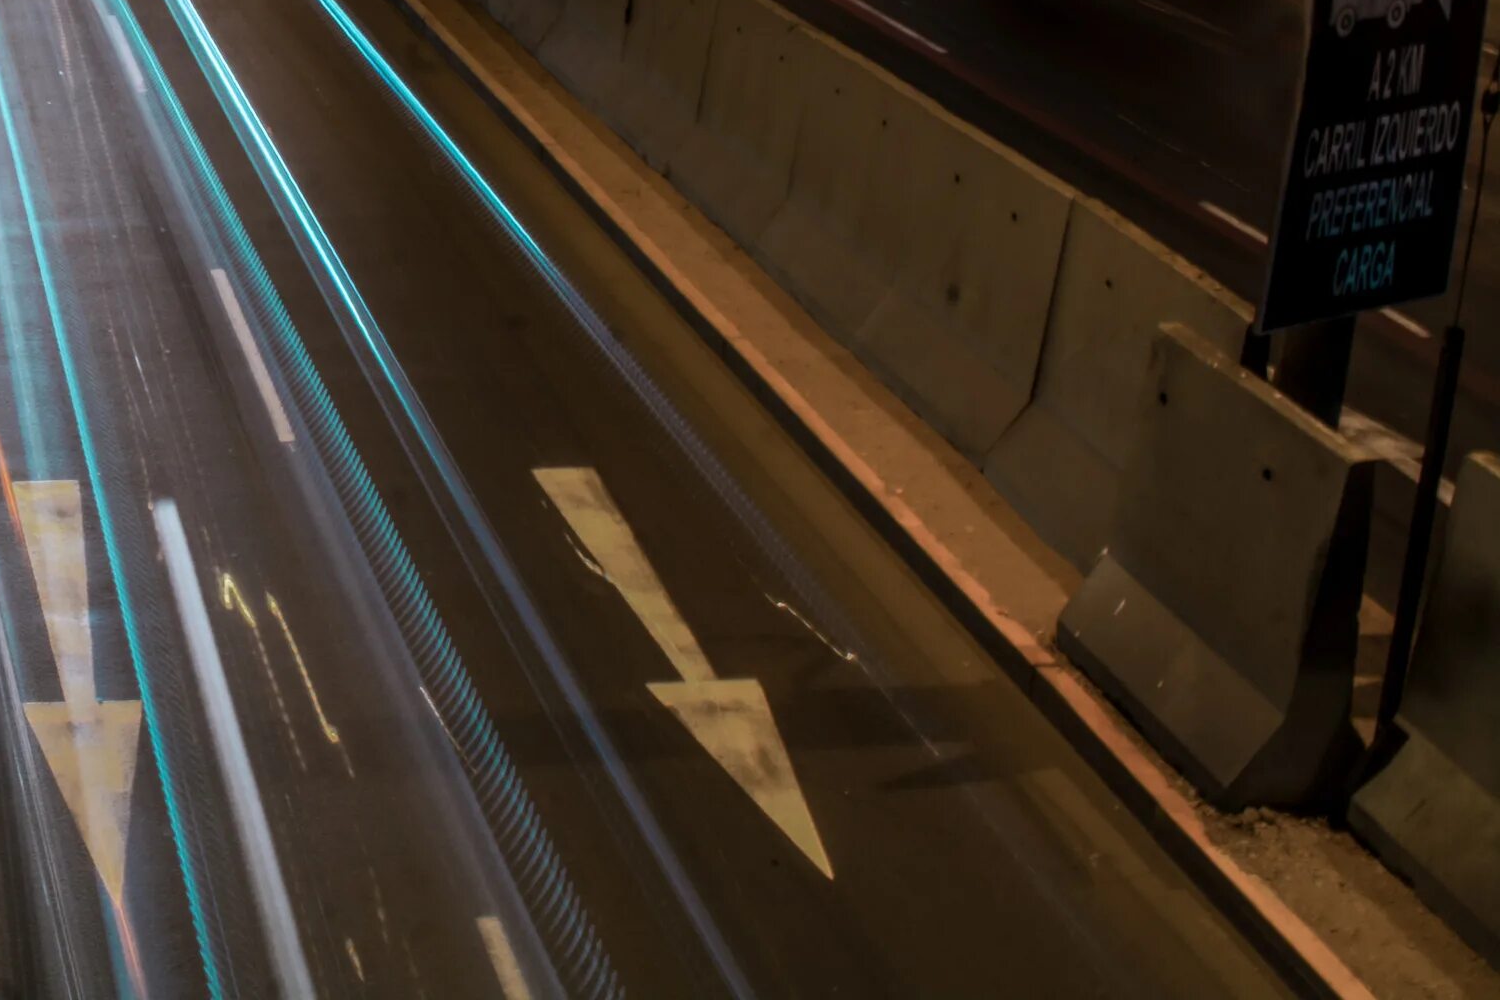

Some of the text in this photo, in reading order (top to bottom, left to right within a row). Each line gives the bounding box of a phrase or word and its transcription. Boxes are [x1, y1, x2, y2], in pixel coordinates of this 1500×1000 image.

[1365, 42, 1426, 102] A 2 KM
[1303, 100, 1461, 179] CARRIL IZQUIERDO
[1305, 168, 1435, 242] PREFERENCIAL
[1332, 240, 1397, 296] CARGA
